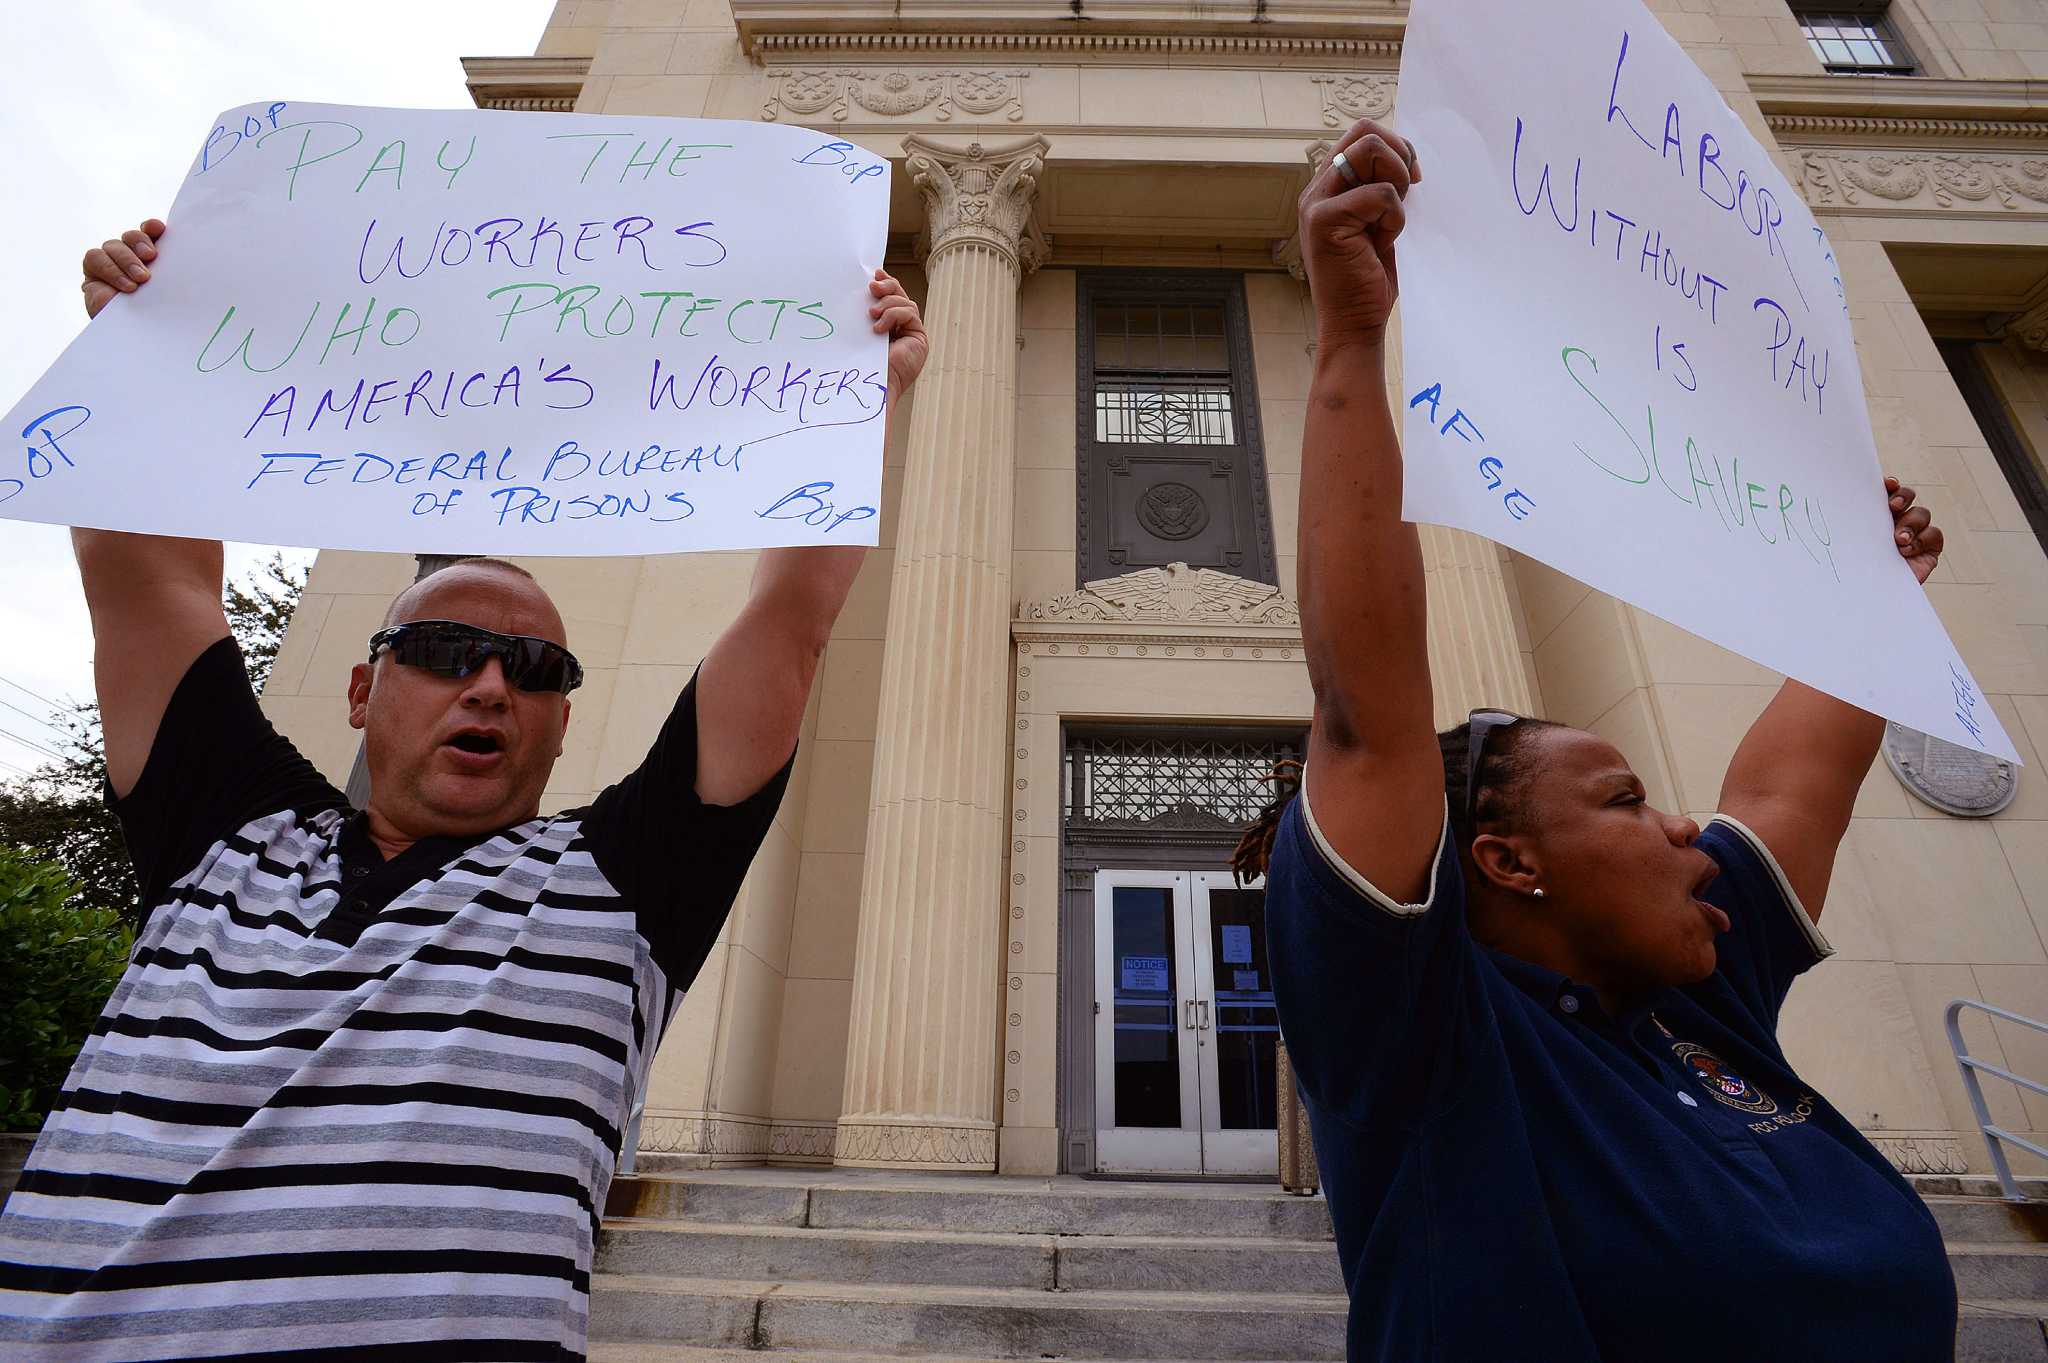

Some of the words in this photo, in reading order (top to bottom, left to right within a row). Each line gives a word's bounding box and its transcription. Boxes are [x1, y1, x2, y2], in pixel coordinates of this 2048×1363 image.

[197, 101, 286, 176] BOP
[256, 120, 477, 201] PAY
[546, 133, 733, 184] THE
[1606, 31, 1810, 313] LABOR
[359, 216, 727, 284] WORKERS
[1512, 116, 1729, 325] WITHOUT
[1754, 298, 1829, 415] PAY
[197, 297, 421, 372] WHO
[486, 283, 835, 344] PROTECTS
[1656, 325, 1697, 392] IS
[243, 357, 594, 438] AMERICA'S
[649, 354, 888, 427] WORKERS
[247, 451, 517, 489] FEDERAL
[542, 441, 744, 482] BUREAU
[1410, 383, 1537, 521] AFGE
[1562, 346, 1840, 583] SLAVERY
[490, 486, 695, 526] PRISONS
[1126, 959, 1164, 970] NOTICE
